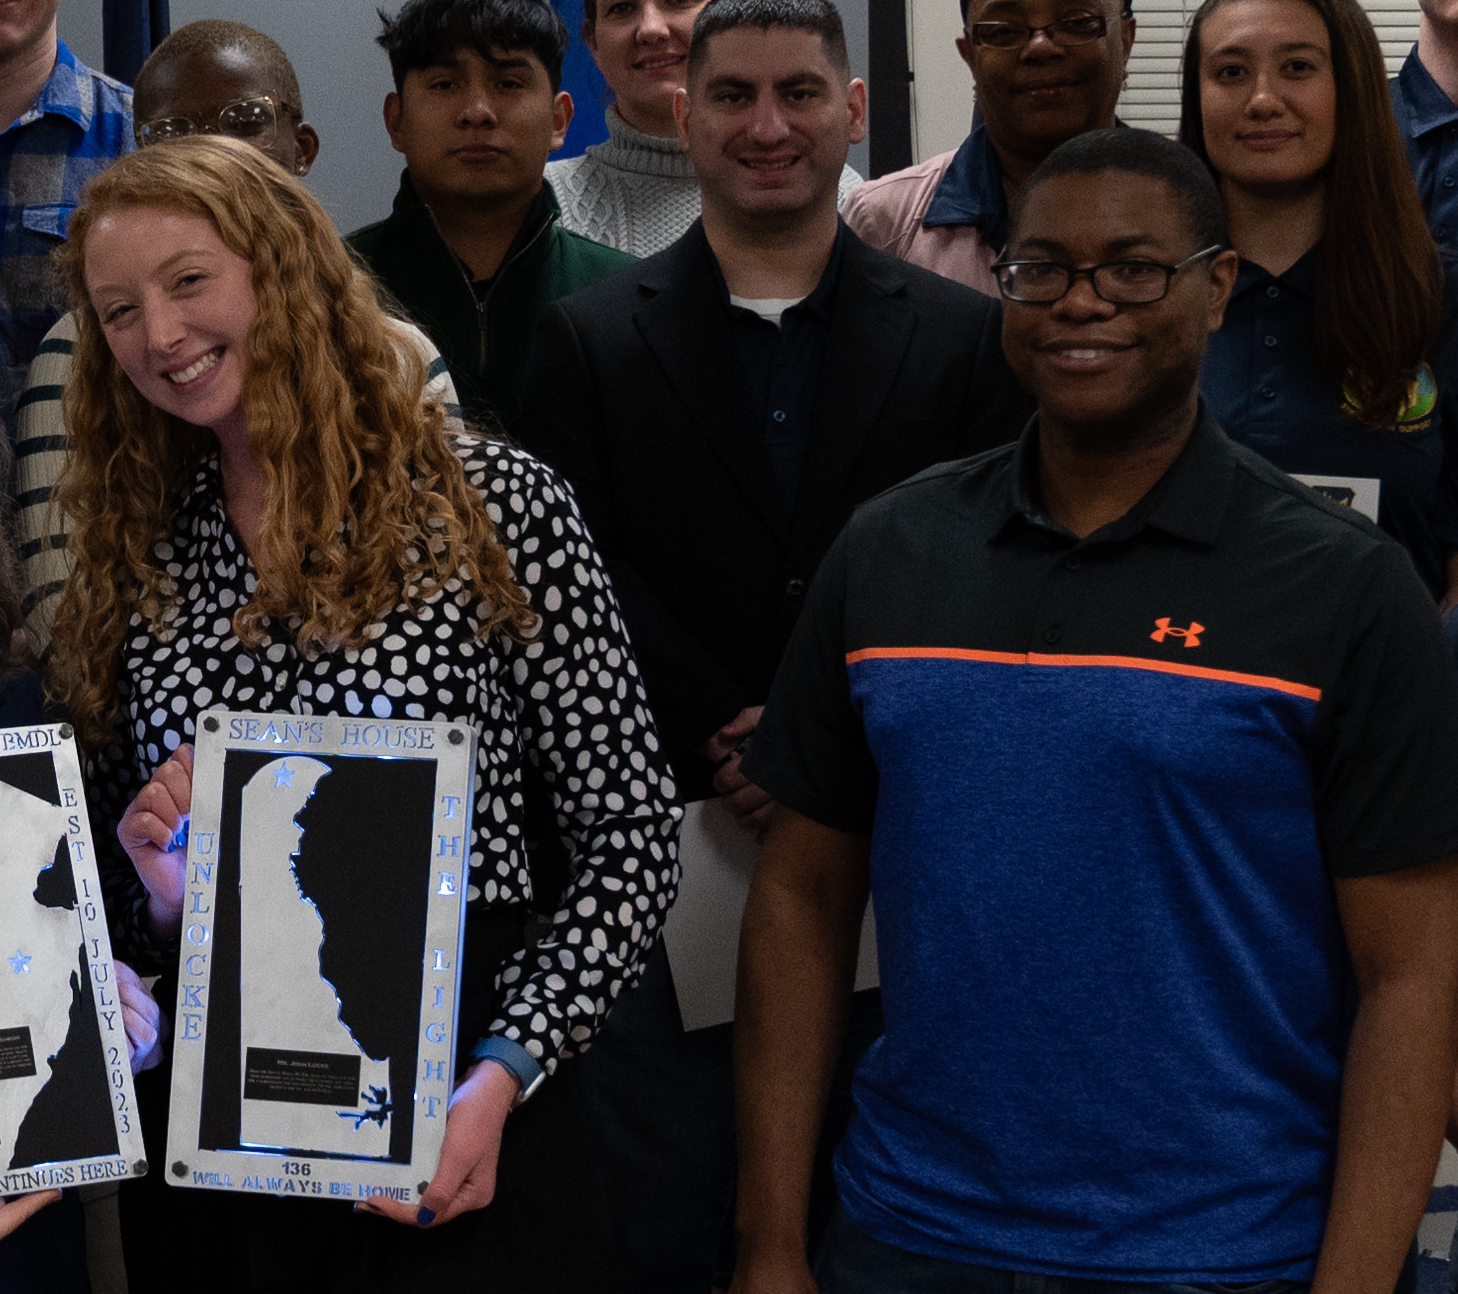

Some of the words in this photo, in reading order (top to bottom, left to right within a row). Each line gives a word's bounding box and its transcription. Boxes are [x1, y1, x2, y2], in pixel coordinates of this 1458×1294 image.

[229, 718, 323, 744] SEAN'S
[341, 723, 434, 750] HOUSE
[436, 795, 461, 897] THE
[62, 788, 85, 862] EST
[82, 879, 96, 921] 10
[90, 938, 116, 1031] JULY
[107, 1047, 131, 1134] 2023
[181, 832, 215, 1041] UNLOCKE
[423, 948, 451, 1118] LIGHT
[81, 1160, 128, 1182] HERE
[193, 1171, 234, 1187] WILL
[241, 1175, 322, 1195] ALWAYS
[329, 1181, 353, 1197] BE
[358, 1183, 412, 1202] HOME
[282, 1161, 311, 1177] 136
